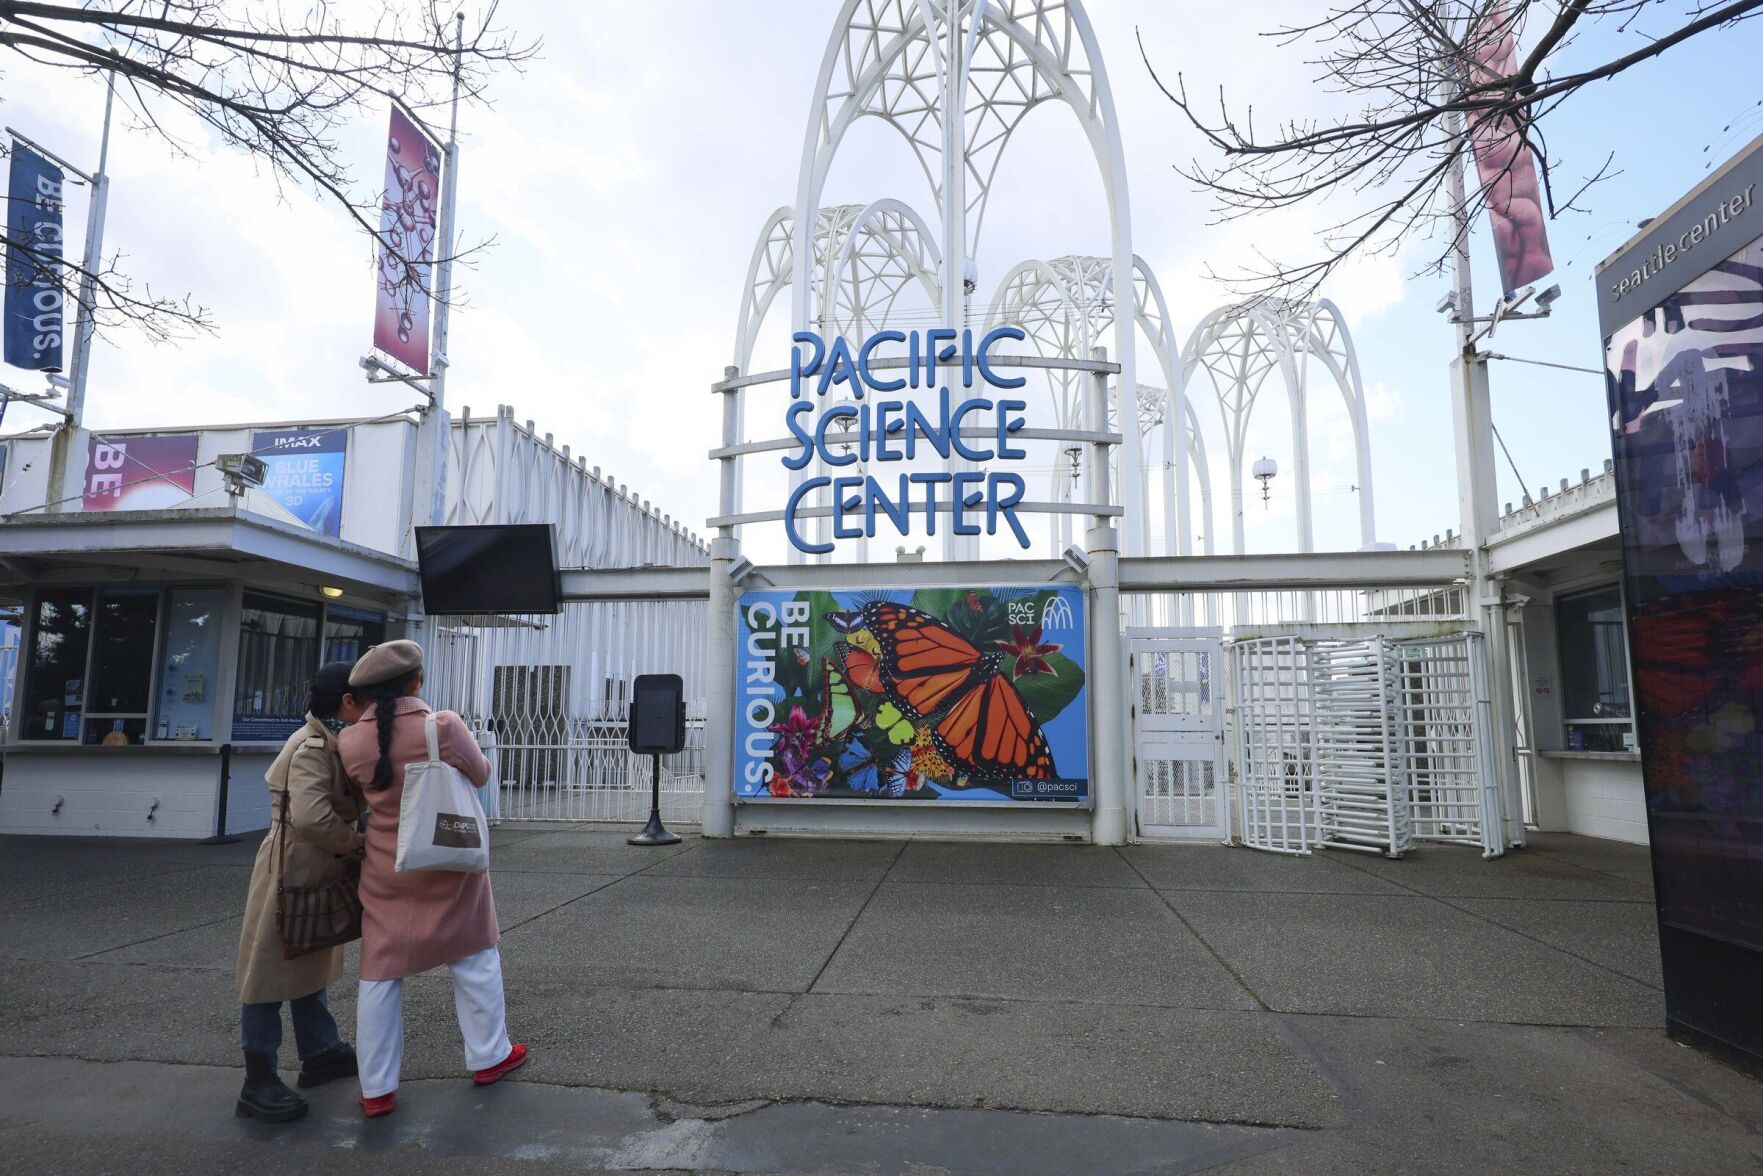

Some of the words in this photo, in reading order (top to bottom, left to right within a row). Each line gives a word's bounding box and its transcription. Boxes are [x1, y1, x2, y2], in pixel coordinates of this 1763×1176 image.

[36, 174, 62, 215] BE
[791, 327, 1026, 400] PACIFIC
[274, 436, 321, 448] IMAX
[781, 386, 1026, 470] SCIENCE
[89, 443, 126, 498] BE
[276, 460, 319, 473] BLUE
[286, 496, 302, 506] 3D
[785, 472, 1030, 554] CENTER
[781, 601, 810, 648] BE
[1008, 602, 1034, 613] PAC
[1008, 613, 1035, 625] SCI
[744, 601, 777, 793] CURIOUS.
[1037, 781, 1078, 793] @pacsci
